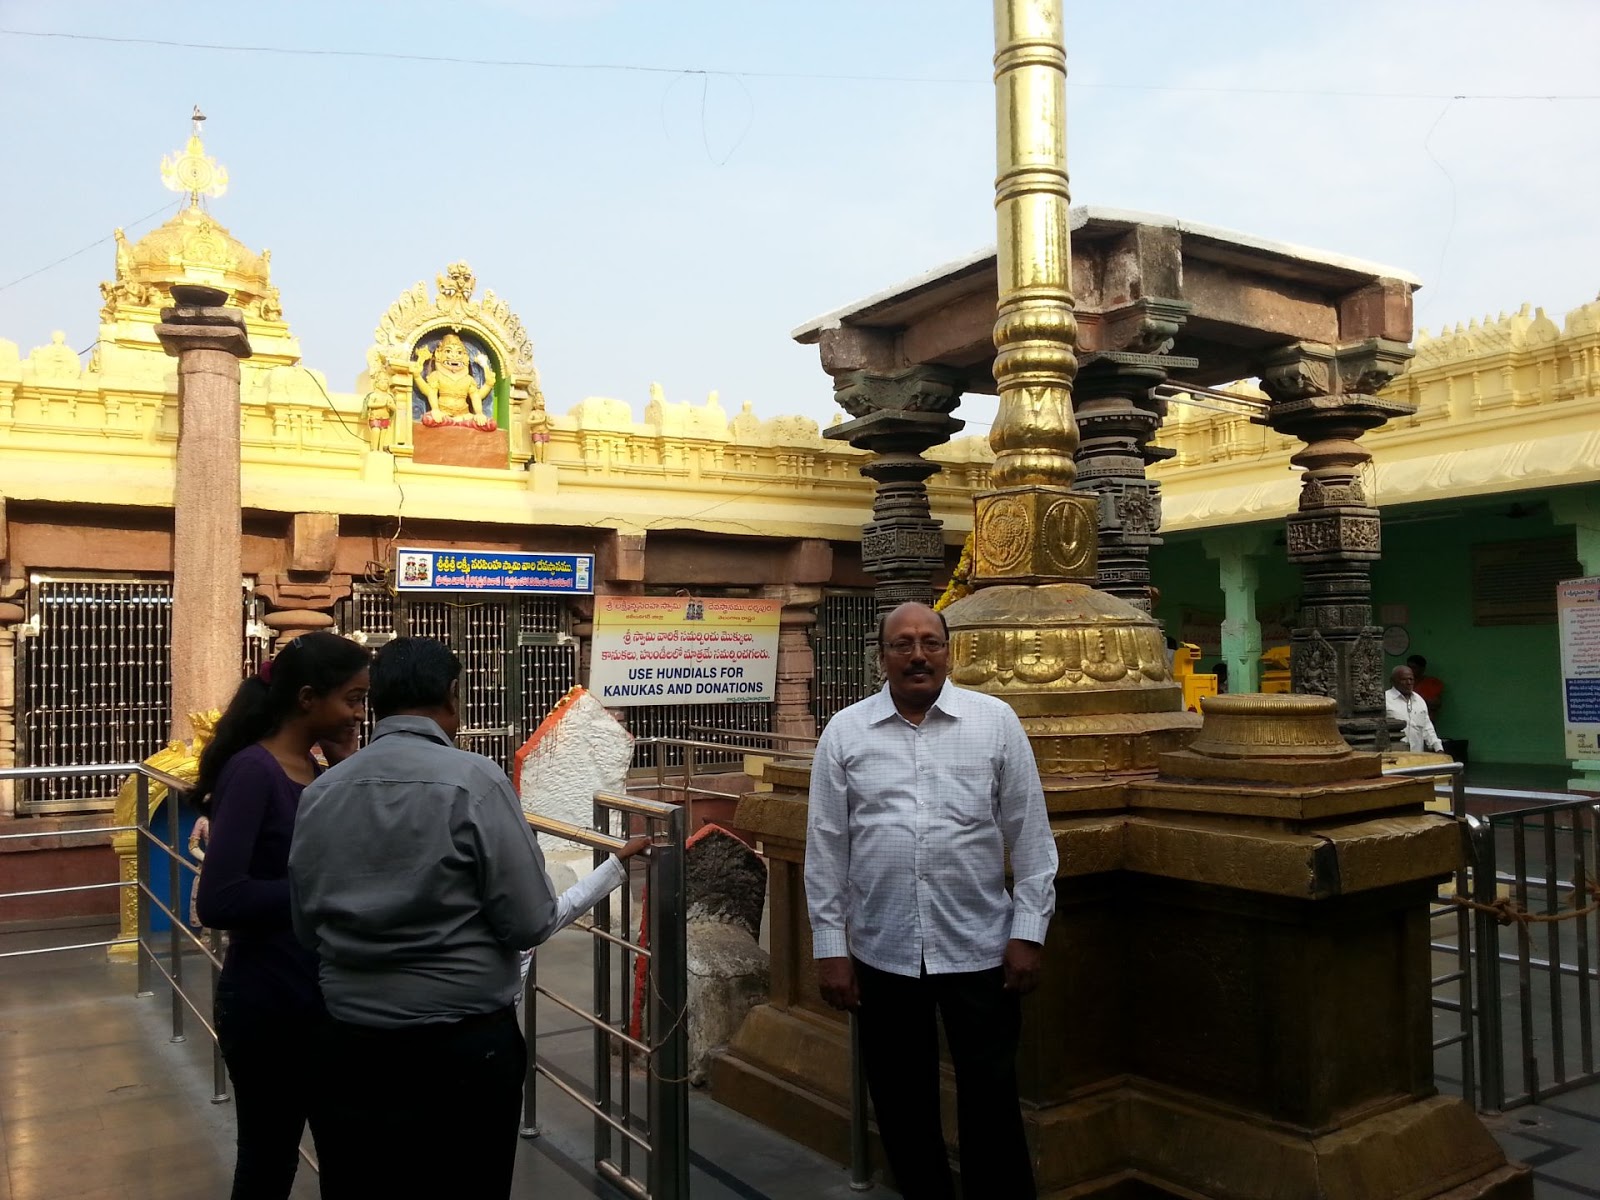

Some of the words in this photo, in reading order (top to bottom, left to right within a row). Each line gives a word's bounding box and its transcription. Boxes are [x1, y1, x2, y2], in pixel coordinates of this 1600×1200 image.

[471, 558, 502, 570] నరసింహ
[502, 560, 521, 574] స్వామి
[521, 561, 536, 571] వారి
[660, 602, 682, 612] స్వామి
[623, 629, 631, 645] శ్రీ
[633, 630, 656, 645] స్వామి
[628, 668, 653, 680] USE
[656, 666, 717, 679] HUNDIALS
[720, 666, 744, 678] FOR
[603, 683, 664, 697] KANUKAS
[666, 683, 692, 695] AND
[696, 681, 763, 694] DONATIONS
